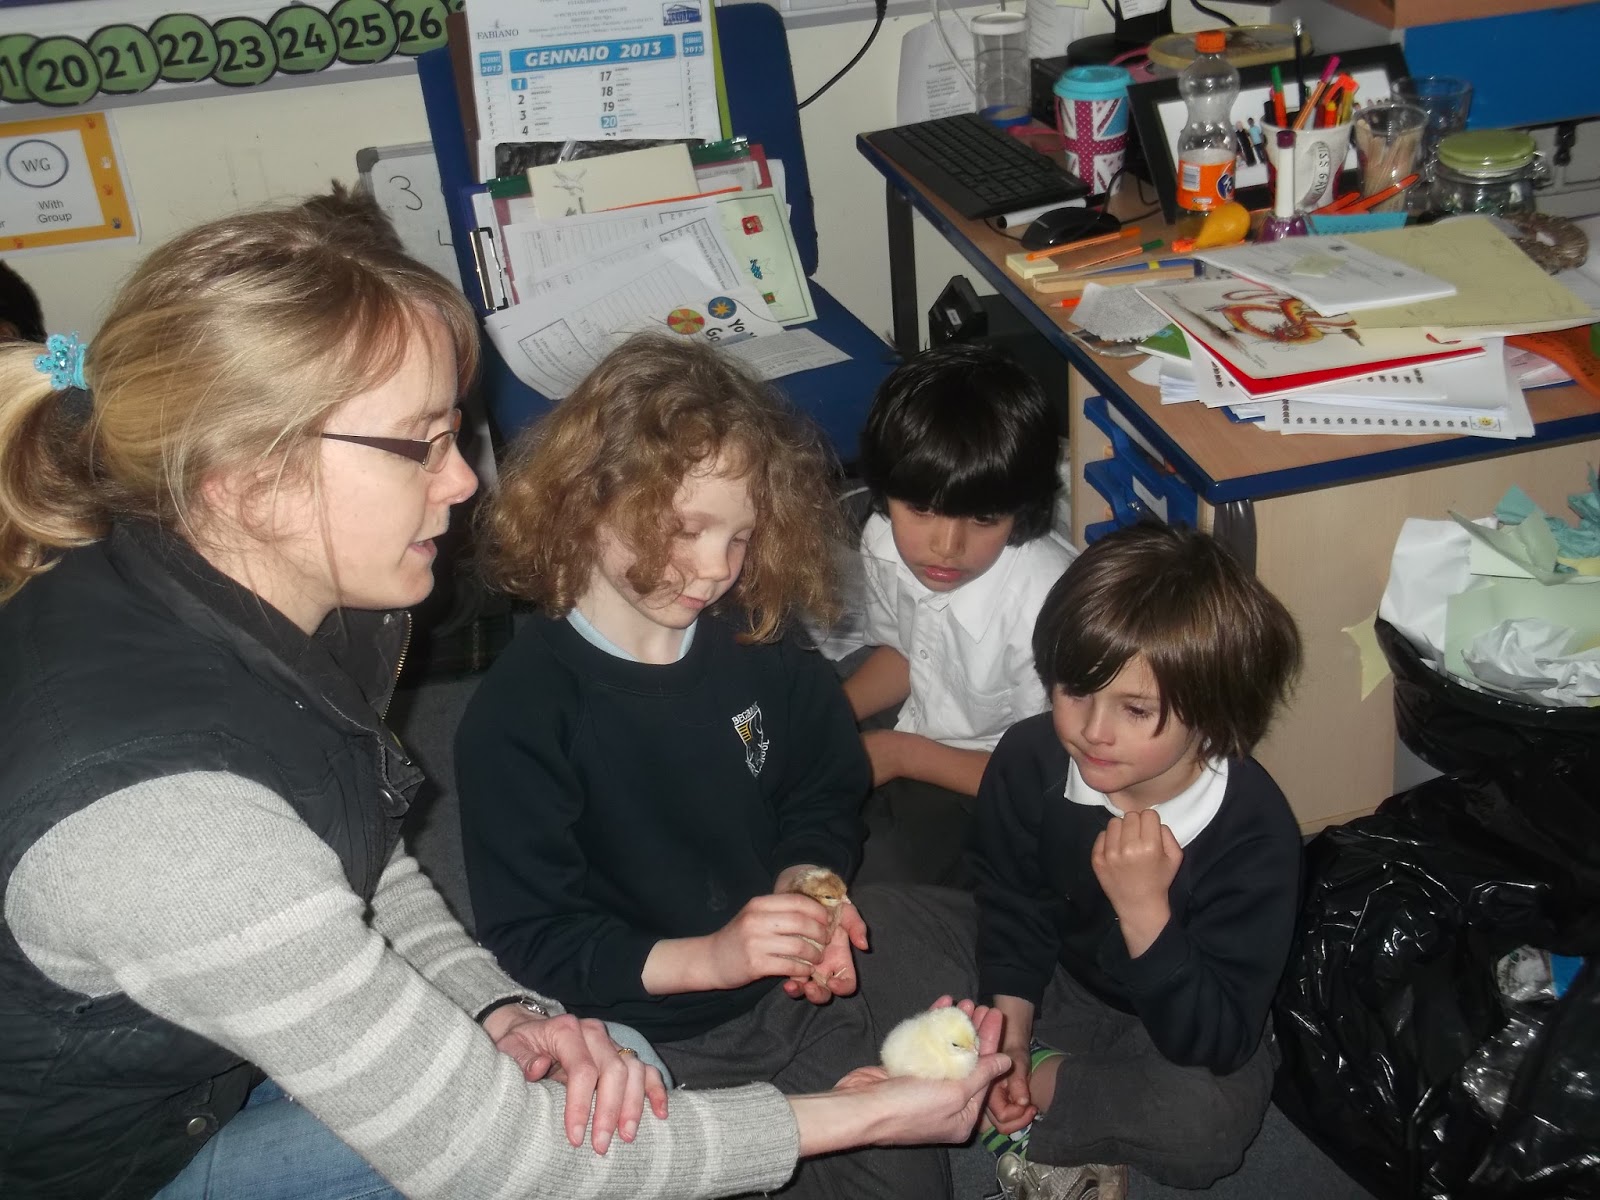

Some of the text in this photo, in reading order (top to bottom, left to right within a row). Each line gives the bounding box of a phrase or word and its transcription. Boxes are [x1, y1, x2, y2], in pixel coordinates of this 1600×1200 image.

[398, 7, 443, 42] 26
[337, 13, 387, 50] 25
[476, 28, 519, 40] FABIANO
[277, 23, 327, 59] 24
[158, 30, 207, 66] 22
[525, 41, 662, 67] GENNAIO 2013
[100, 42, 146, 79] 21
[220, 37, 265, 72] 23
[482, 65, 502, 73] 2012
[38, 60, 89, 92] 20
[600, 71, 612, 81] 17
[602, 86, 613, 97] 18
[518, 95, 525, 105] 2
[603, 102, 615, 112] 19
[520, 110, 527, 120] 3
[603, 117, 616, 128] 20
[522, 126, 529, 135] 4
[21, 157, 51, 173] WG
[389, 175, 423, 211] 3
[38, 200, 64, 210] With
[38, 213, 73, 223] Group
